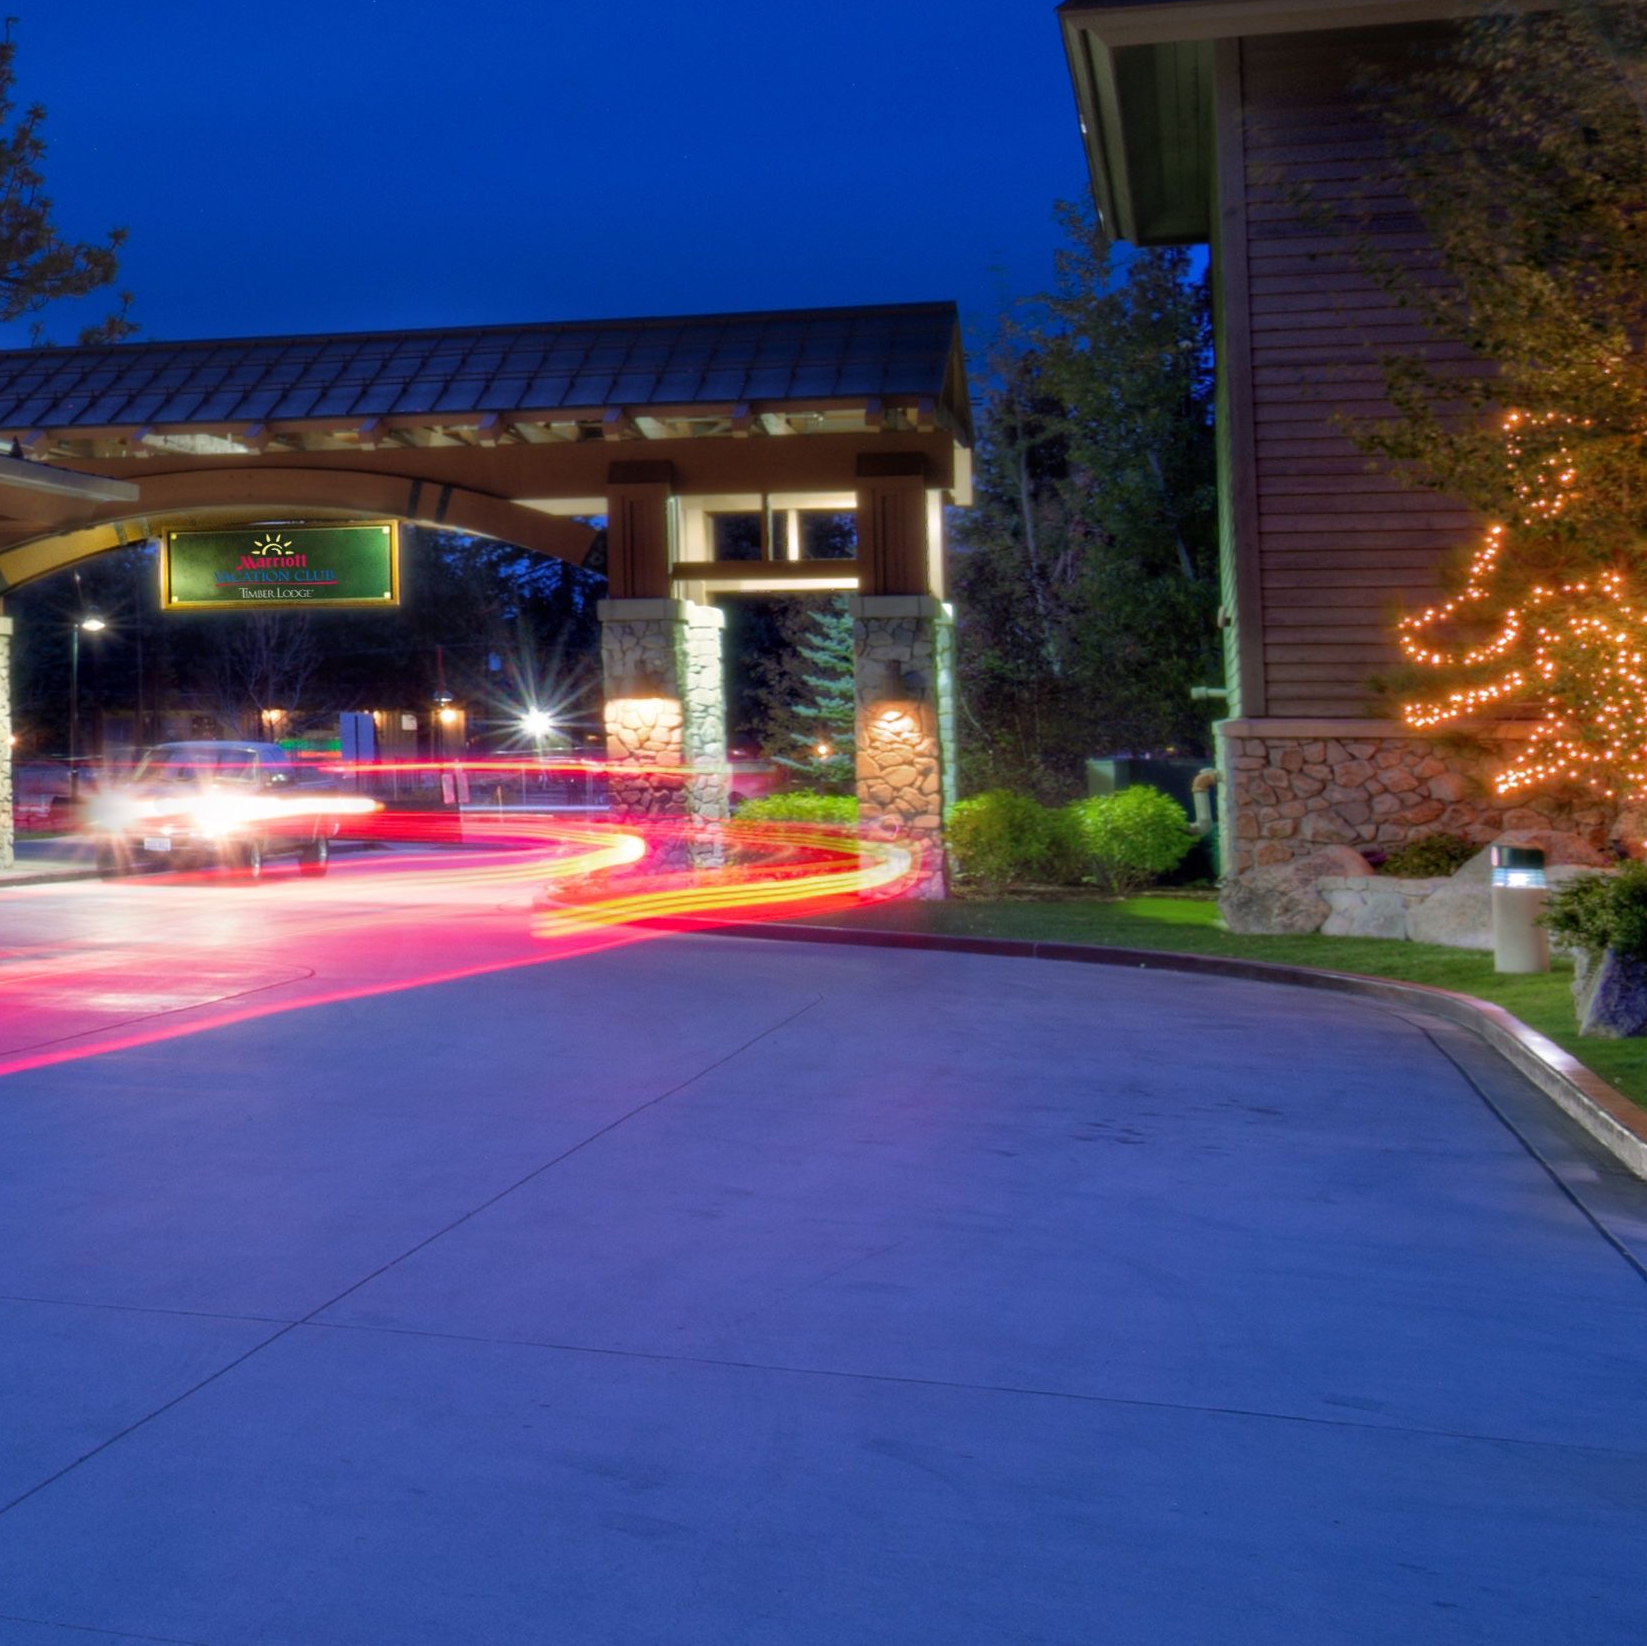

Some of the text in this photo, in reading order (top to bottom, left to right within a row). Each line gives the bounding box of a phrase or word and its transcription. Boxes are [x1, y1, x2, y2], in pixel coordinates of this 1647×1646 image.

[235, 554, 307, 570] Marriott
[214, 569, 336, 582] VACATION CLUB
[239, 587, 275, 598] TIMBER
